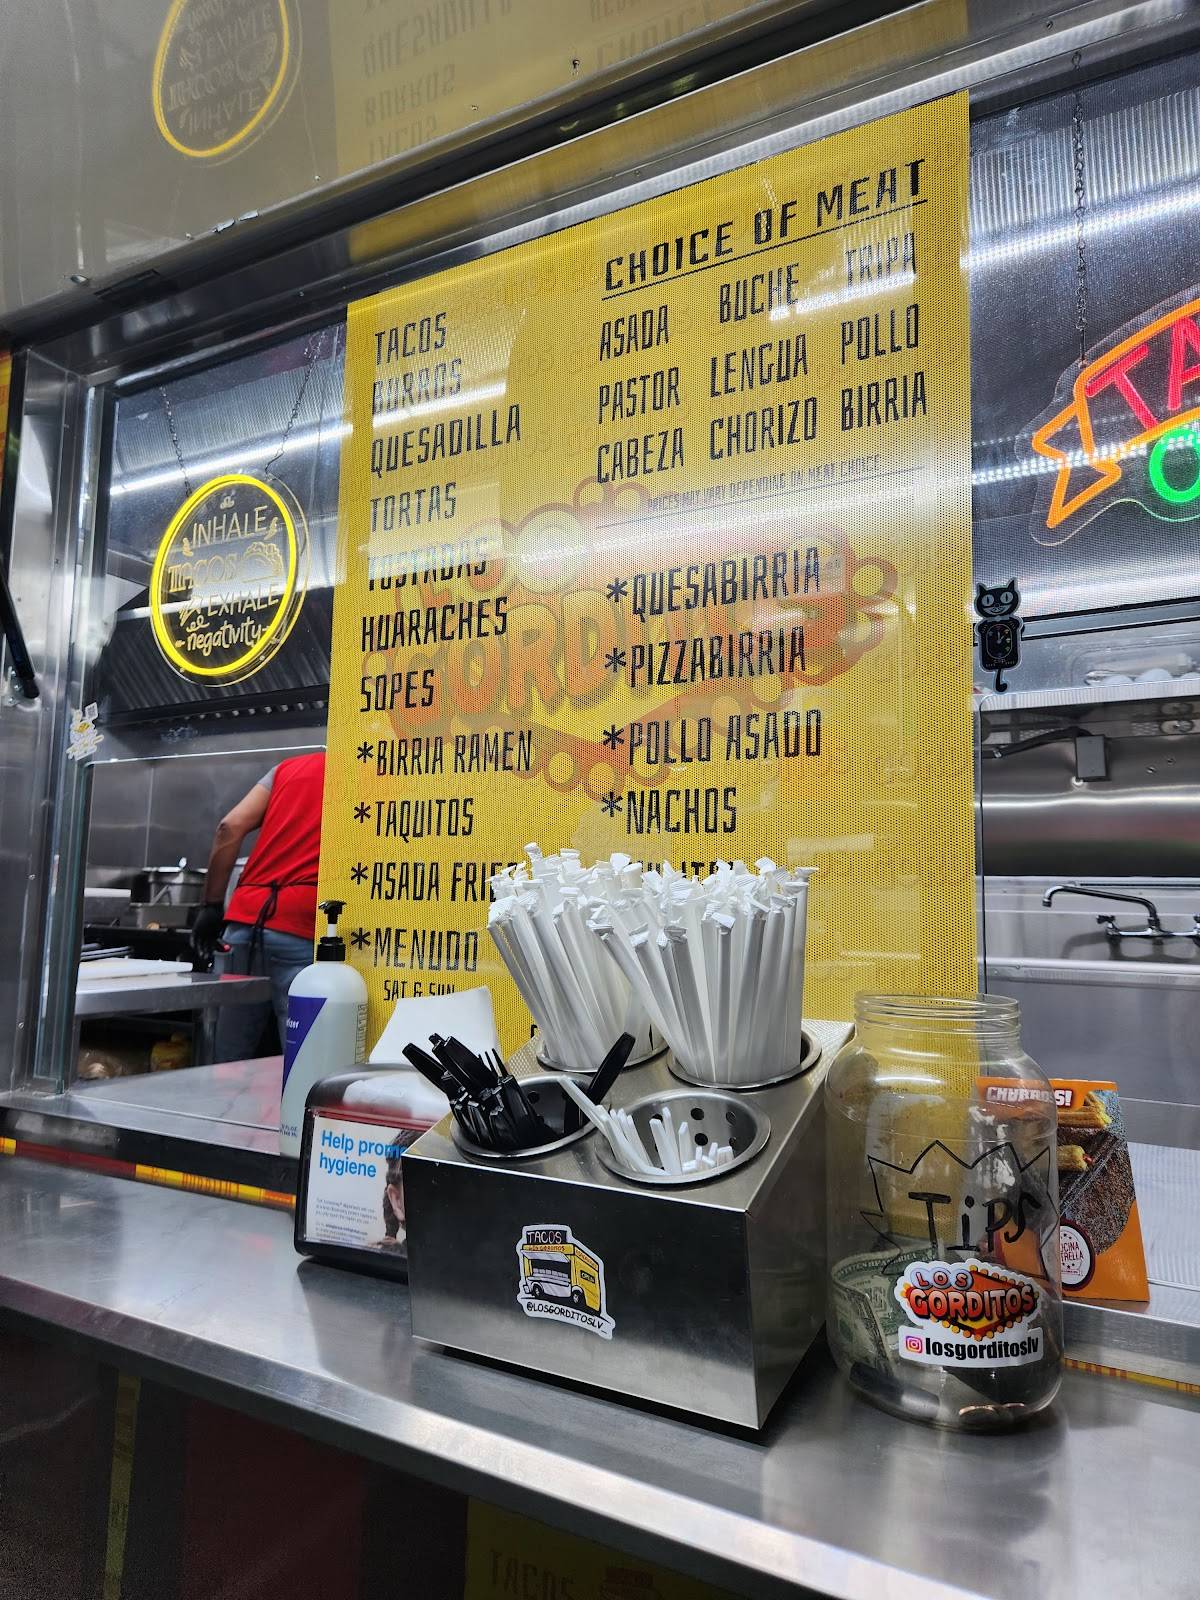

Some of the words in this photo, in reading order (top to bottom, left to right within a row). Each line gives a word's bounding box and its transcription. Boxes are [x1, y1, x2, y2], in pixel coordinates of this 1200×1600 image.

[605, 220, 733, 291] CHOICE
[754, 200, 797, 245] OF
[816, 159, 925, 228] MEAT
[719, 263, 799, 323] BUCHE
[845, 232, 916, 289] TRIPA
[374, 312, 447, 365] TACOS
[599, 305, 669, 361] ASADA
[709, 334, 808, 398] LENGUA
[841, 303, 920, 365] POLLO
[371, 358, 462, 417] BURROS
[598, 366, 681, 425] PASTOR
[370, 403, 521, 478] QUESADILLA
[597, 427, 684, 484] CABEZA
[709, 396, 817, 460] CHORIZO
[841, 371, 927, 432] BIRRIA
[192, 505, 268, 548] INHALE
[370, 482, 457, 533] TORTAS
[168, 553, 237, 592] TACOS
[368, 537, 489, 592] TOSTADAS
[208, 581, 280, 617] EXHALE
[361, 596, 508, 652] HUARACHES
[360, 669, 435, 713] SOPES
[453, 730, 532, 774] RAMEN
[725, 709, 821, 761] ASADO
[451, 861, 518, 902] FRIE
[383, 980, 408, 1002] SAT
[319, 1152, 377, 1178] hygiene
[321, 1129, 355, 1155] Help
[527, 1230, 562, 1244] TACOS
[908, 1283, 1038, 1321] GORDITOS
[914, 1270, 970, 1290] LOS
[925, 1336, 1039, 1361] losgorditoslv
